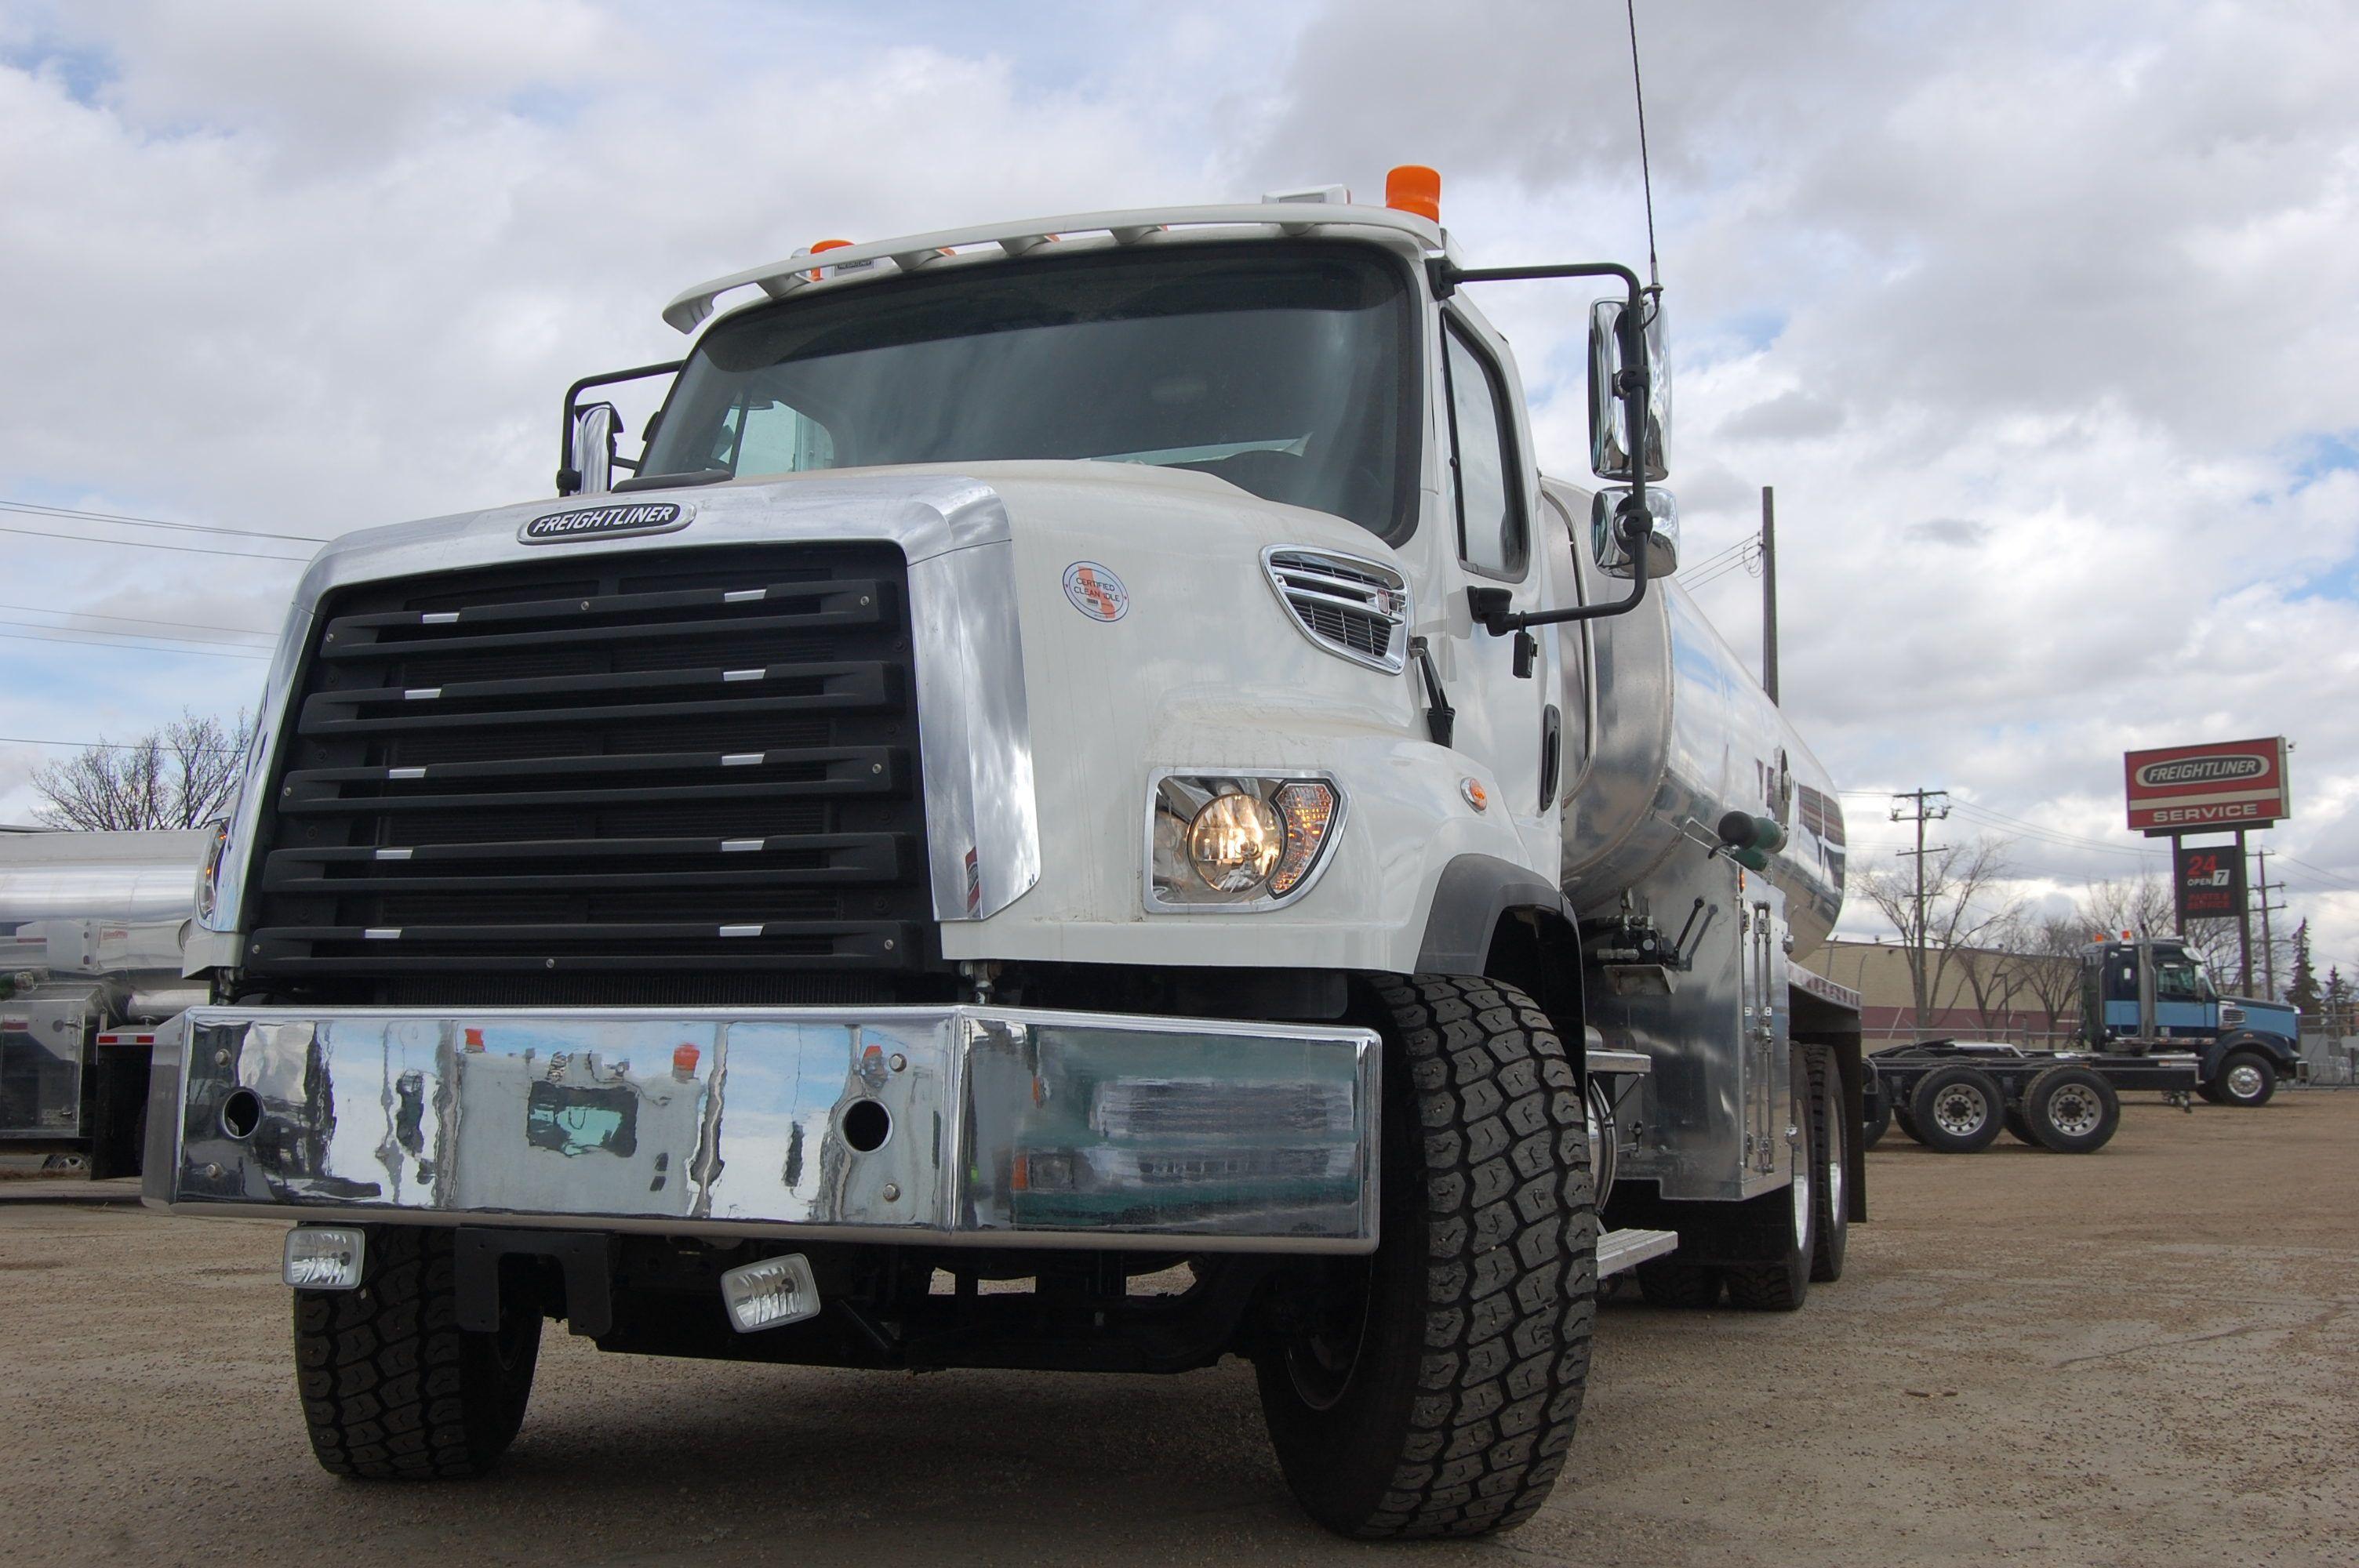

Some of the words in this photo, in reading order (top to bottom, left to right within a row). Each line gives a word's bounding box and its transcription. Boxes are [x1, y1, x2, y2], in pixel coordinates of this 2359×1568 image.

[533, 506, 674, 534] FREIGHTLINER
[1074, 586, 1100, 597] CLEAN
[1103, 592, 1120, 602] IDLE
[1076, 577, 1115, 592] CERTIFIED
[2148, 760, 2257, 782] FREIGHTLINER
[2153, 804, 2258, 823] SERVICE
[2187, 855, 2217, 877] 24
[2186, 877, 2212, 887] OPEN
